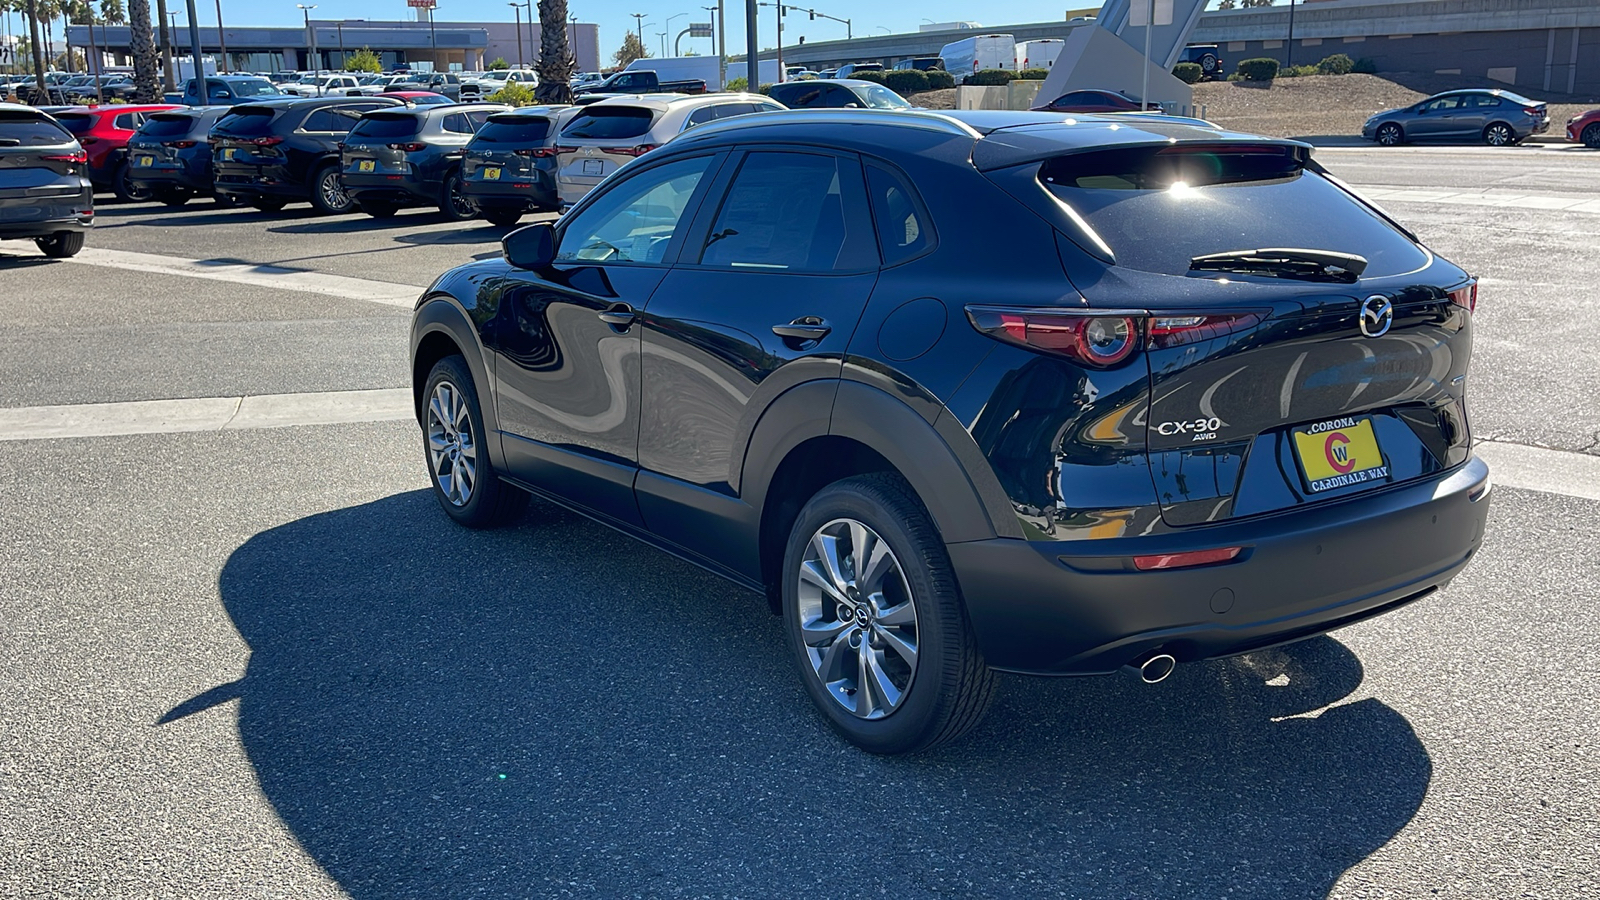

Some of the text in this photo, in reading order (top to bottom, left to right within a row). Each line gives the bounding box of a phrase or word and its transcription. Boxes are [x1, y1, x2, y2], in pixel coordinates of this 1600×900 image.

[1157, 417, 1221, 436] CX-30
[1311, 417, 1355, 433] CORONA
[1192, 432, 1217, 441] AWD
[1311, 466, 1388, 491] CARDINALE WAY
